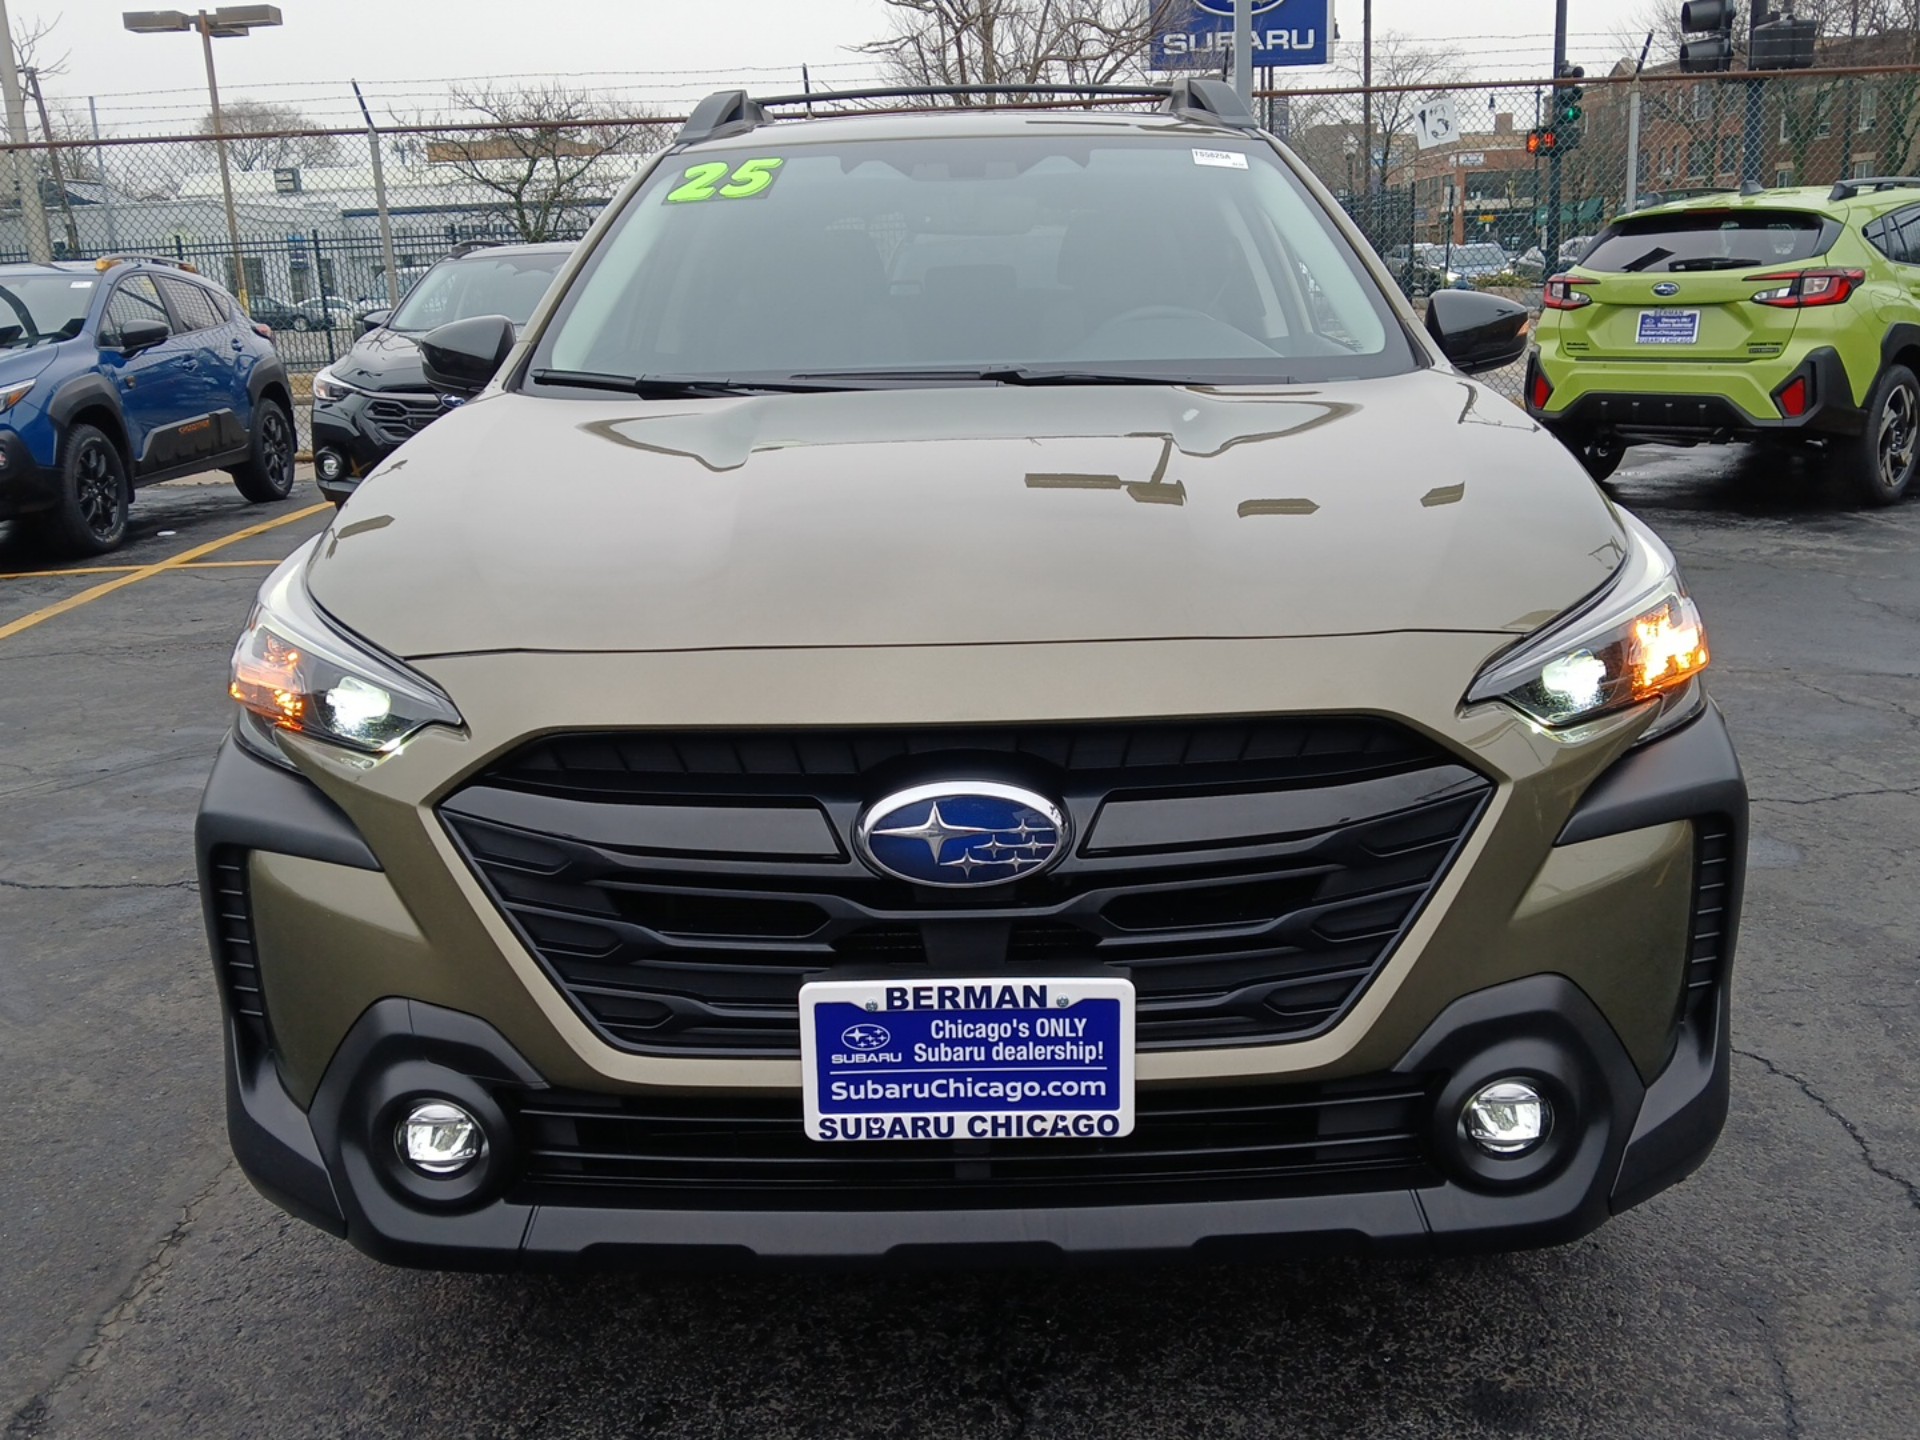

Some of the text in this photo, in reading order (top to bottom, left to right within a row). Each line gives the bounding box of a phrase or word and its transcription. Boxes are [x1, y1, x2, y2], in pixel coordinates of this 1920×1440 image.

[1418, 103, 1452, 140] 13
[667, 157, 784, 203] 25
[886, 985, 1048, 1011] BERMAN
[931, 1018, 1088, 1042] Chicago's ONLY
[831, 1053, 902, 1064] SUBARU
[914, 1041, 1105, 1064] Subaru dealership!
[831, 1079, 1107, 1102] SubaruChicago.com
[818, 1114, 1121, 1140] SUBARU CHICAGO
